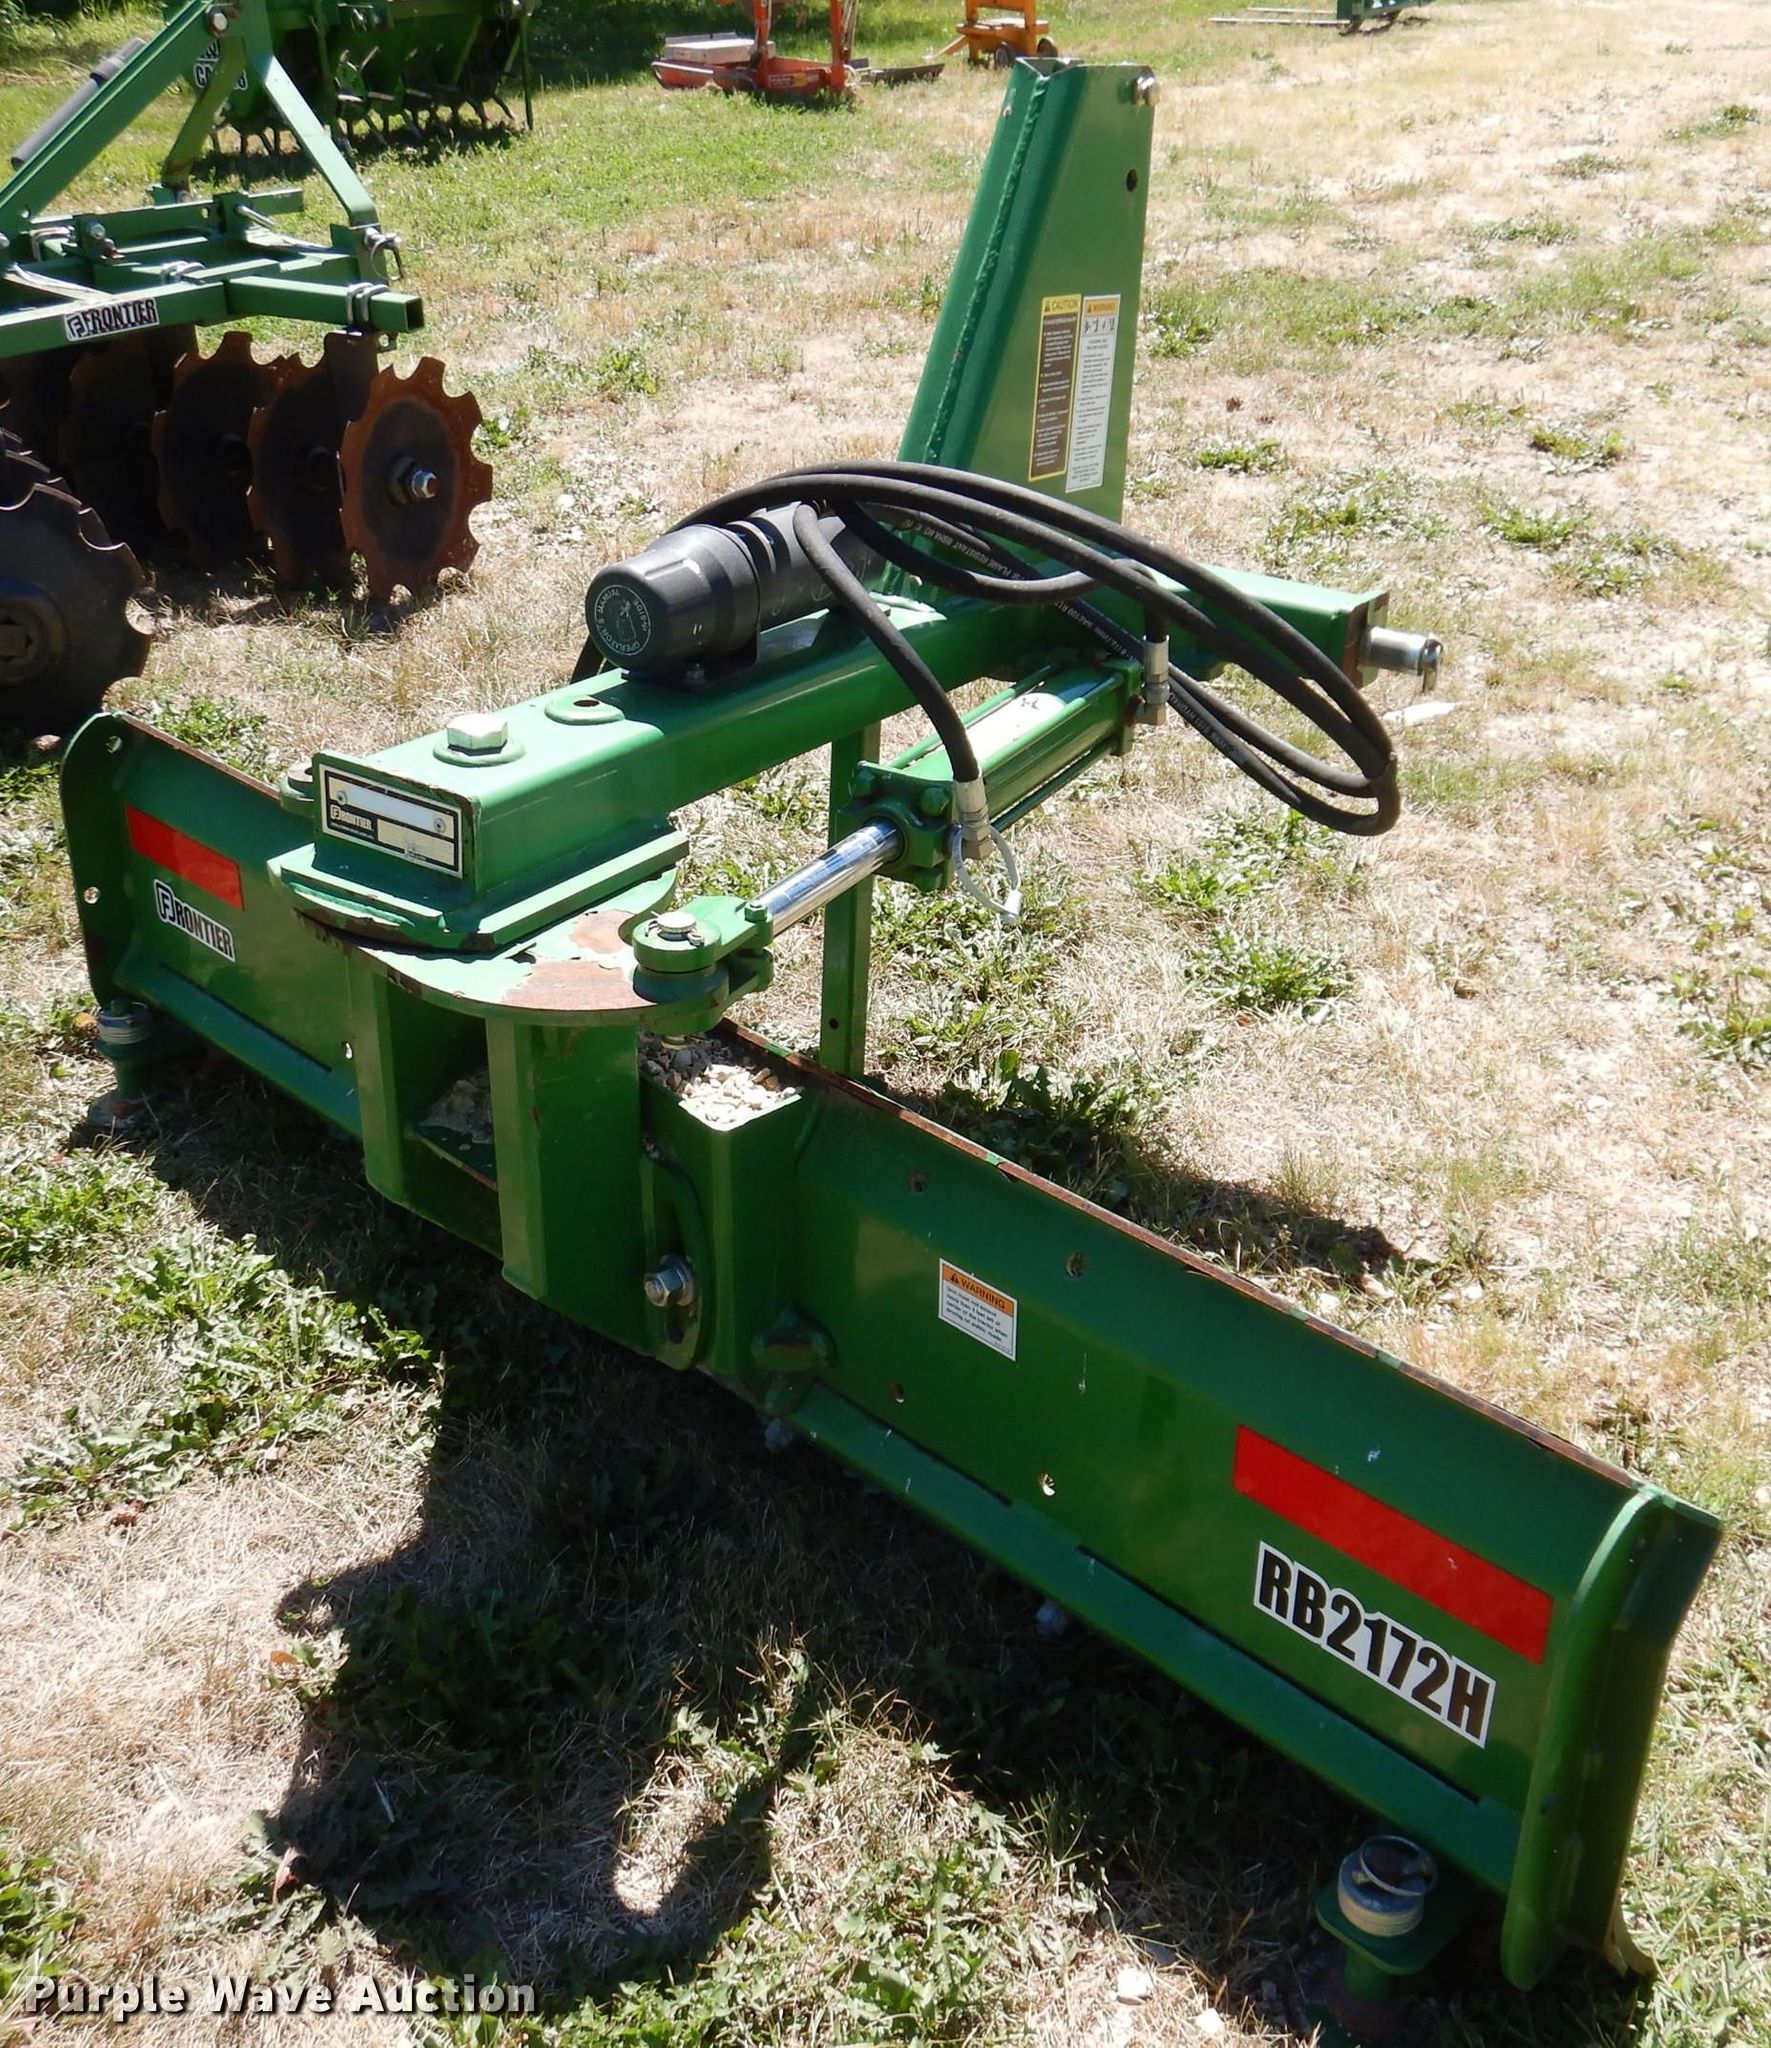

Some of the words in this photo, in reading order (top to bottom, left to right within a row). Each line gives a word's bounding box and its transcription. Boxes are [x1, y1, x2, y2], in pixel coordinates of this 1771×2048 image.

[155, 881, 234, 960] FRONTIER
[961, 1277, 1005, 1310] WARNING
[1258, 1548, 1491, 1741] RB2172H
